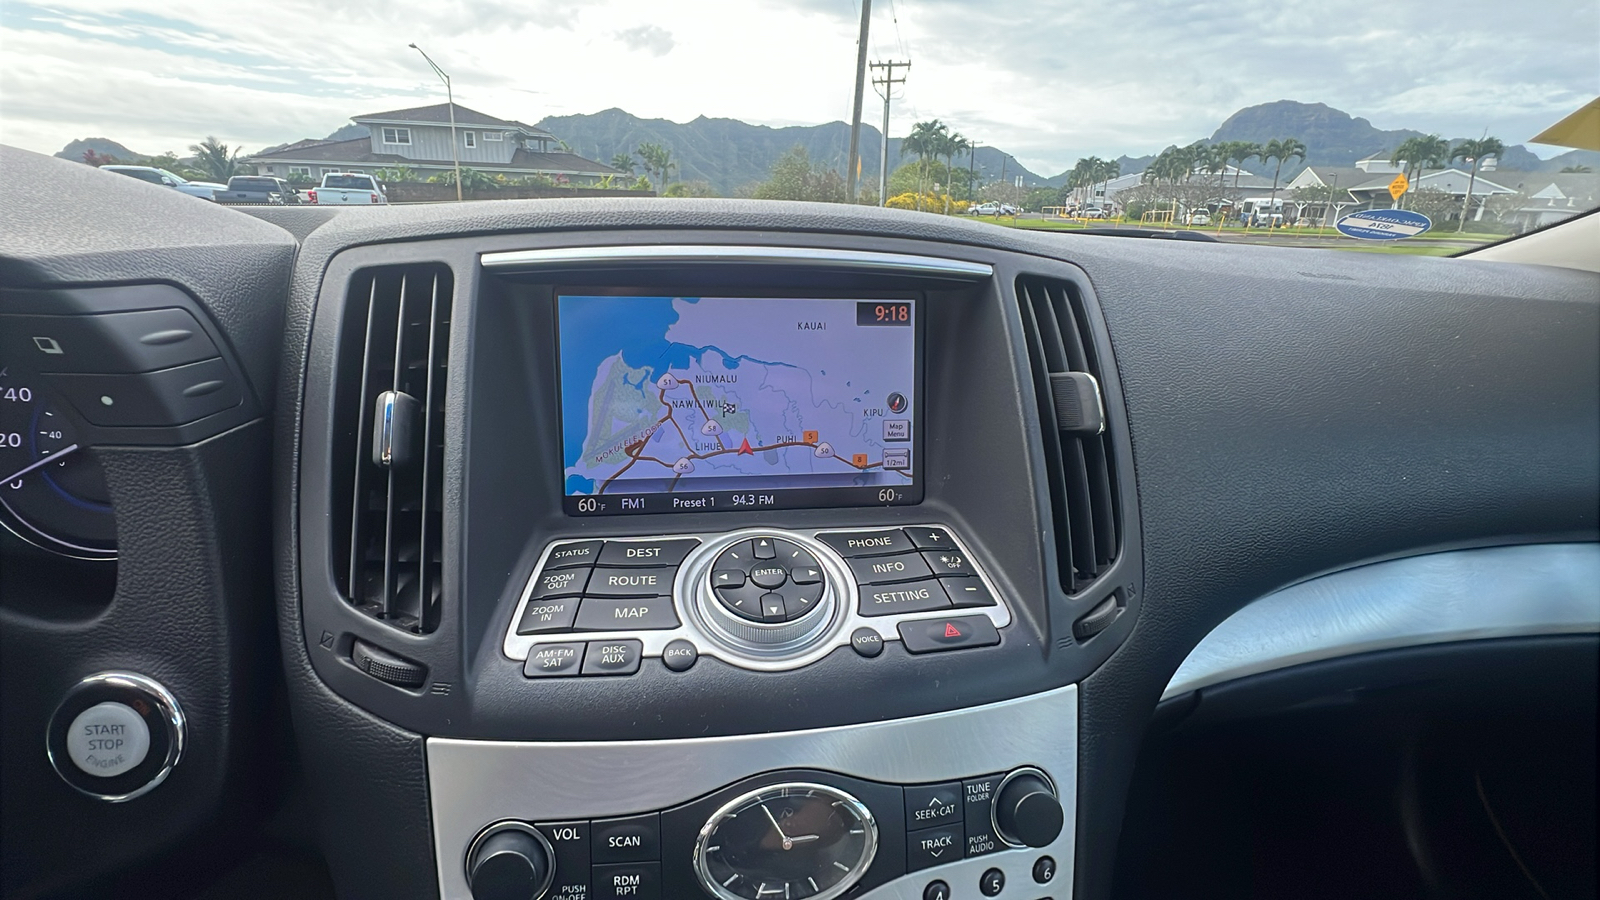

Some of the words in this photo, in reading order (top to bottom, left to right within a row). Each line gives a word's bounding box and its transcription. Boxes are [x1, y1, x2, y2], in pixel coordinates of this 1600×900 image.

[875, 305, 908, 321] 9:18
[797, 322, 826, 330] KAUAI
[695, 375, 738, 383] NIUMALU
[4, 387, 32, 402] 40
[672, 399, 726, 408] NAWIIWIL
[863, 408, 884, 417] KIPU
[49, 430, 62, 439] 40
[776, 435, 797, 443] PUHI
[695, 443, 721, 451] LIHUE
[621, 498, 645, 509] FM1
[673, 498, 706, 508] Preset
[710, 497, 715, 507] 1
[732, 494, 755, 506] 94.3
[759, 495, 774, 505] FM
[848, 536, 892, 548] PHONE
[554, 548, 590, 559] STATUS
[626, 548, 661, 558] DEST
[755, 568, 783, 577] ENTER
[872, 561, 905, 574] INFO
[543, 573, 575, 584] ZOOM
[608, 575, 657, 586] ROUTE
[547, 580, 569, 589] OUT
[873, 588, 930, 604] SETTING
[531, 605, 564, 615] ZOOM
[614, 607, 649, 619] MAP
[540, 613, 552, 622] IN
[856, 635, 880, 644] VOICE
[602, 645, 627, 655] DISC
[668, 649, 692, 657] BACK
[543, 658, 563, 668] SAT
[602, 655, 625, 664] AUX
[84, 724, 126, 736] START
[88, 738, 124, 751] STOP
[85, 754, 126, 769] ENGINE
[966, 782, 991, 793] TUNE
[967, 792, 990, 803] FOLDER
[552, 828, 580, 841] VOL
[968, 834, 989, 845] PUSH
[608, 836, 641, 848] SCAN
[921, 836, 952, 850] TRACK
[969, 840, 995, 855] AUDIO
[1044, 868, 1051, 880] 6
[613, 875, 640, 887] RDM
[992, 880, 1000, 893] 5
[561, 885, 586, 894] PUSH
[616, 886, 638, 896] RPT
[935, 891, 943, 900] 4
